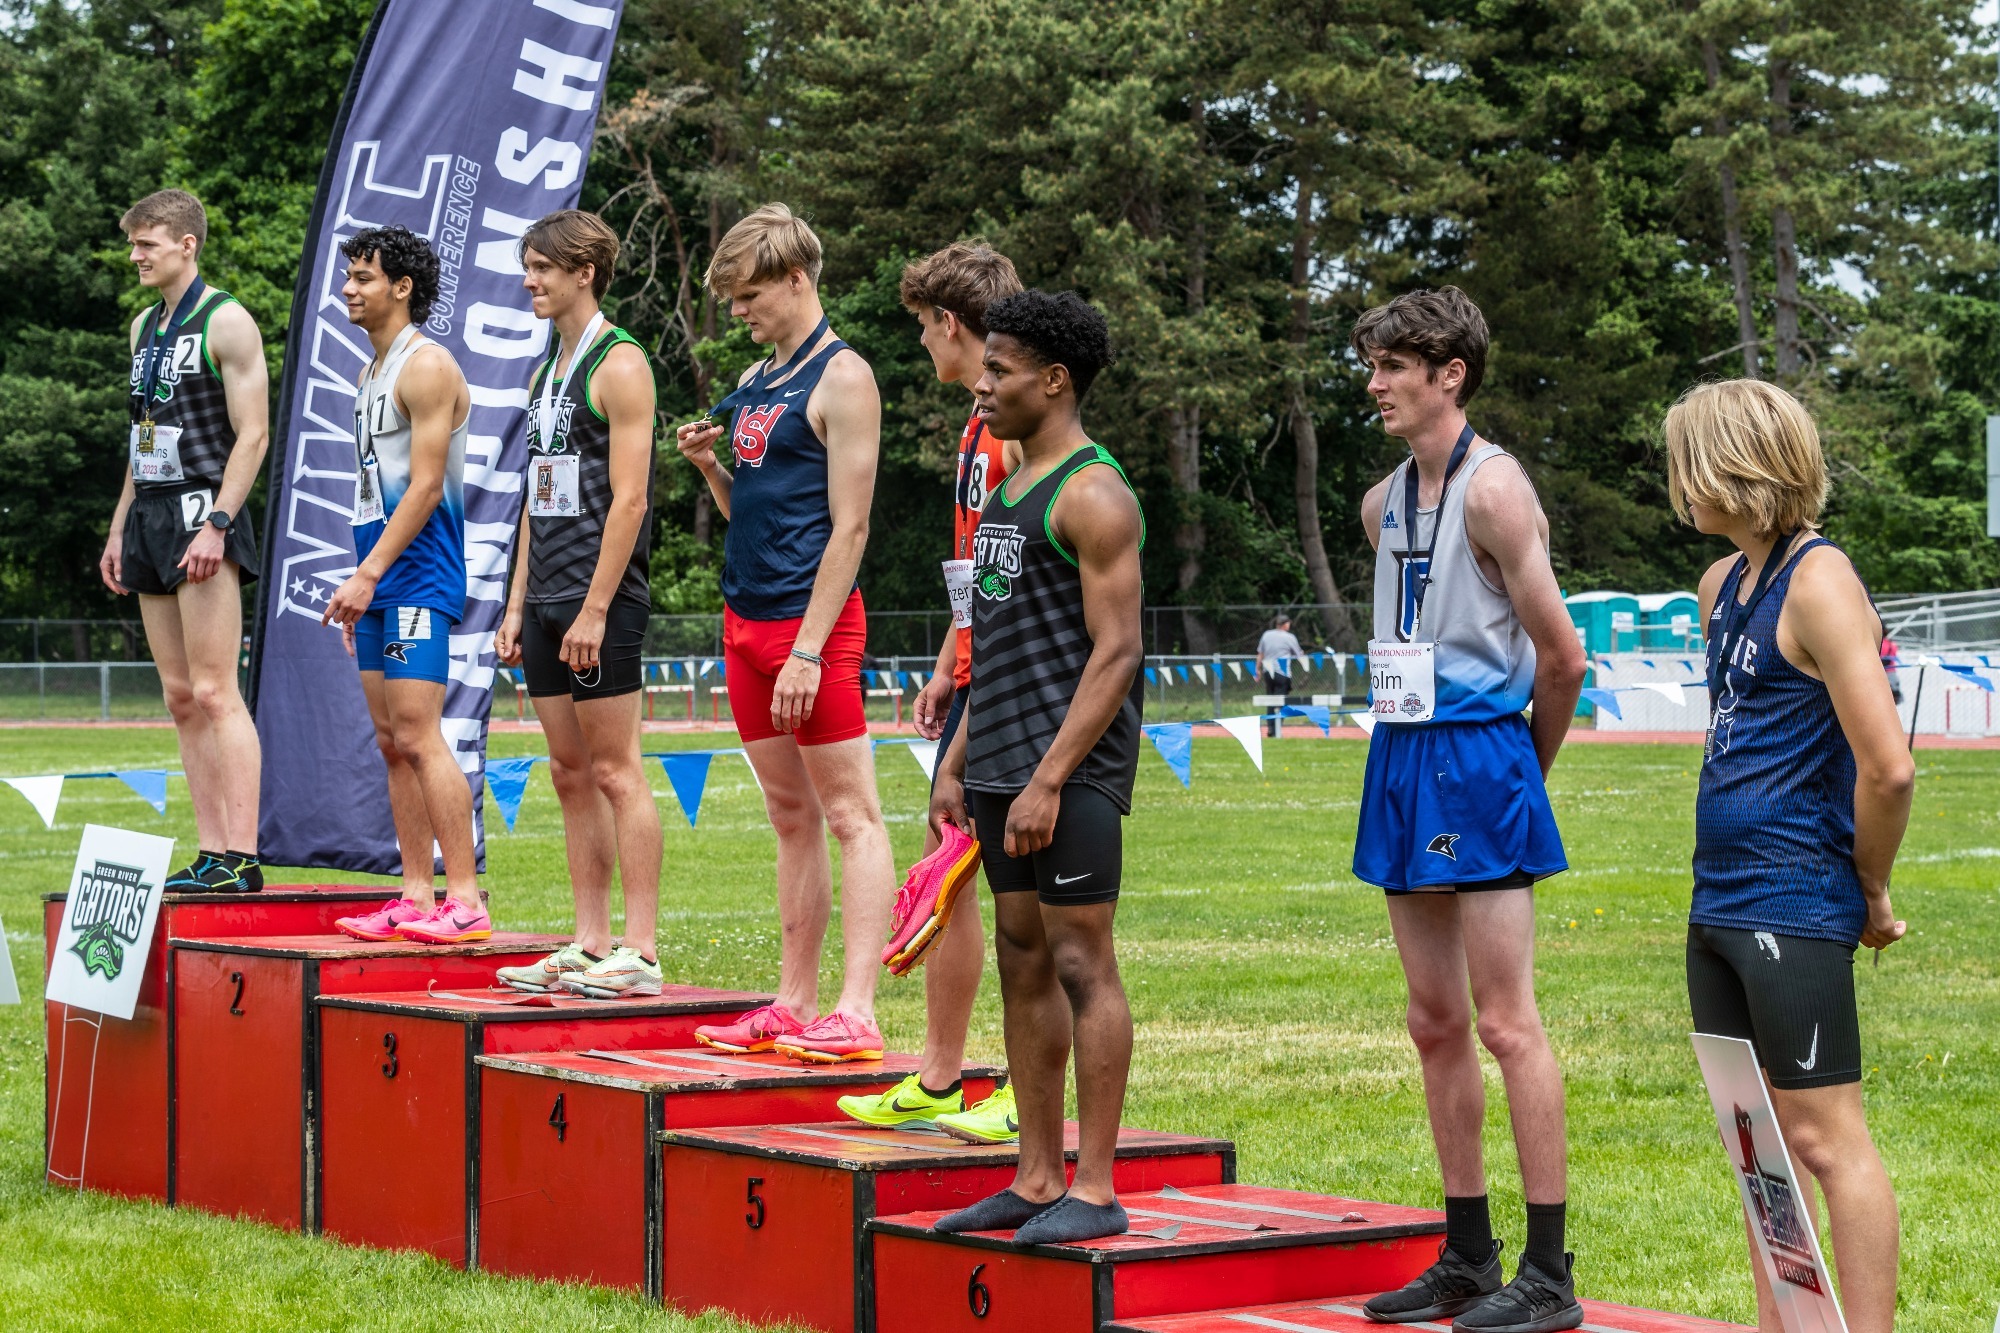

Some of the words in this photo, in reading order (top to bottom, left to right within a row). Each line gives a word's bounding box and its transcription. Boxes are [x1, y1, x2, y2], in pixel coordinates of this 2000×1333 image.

[425, 155, 481, 336] CONFERENCE
[178, 337, 195, 371] 2
[377, 393, 387, 432] 7
[142, 464, 158, 475] 2023
[970, 462, 983, 509] 8
[189, 493, 205, 528] 2
[1369, 649, 1422, 657] HAMPIONSHIPS
[1371, 670, 1402, 690] olm
[1374, 699, 1396, 714] 023
[96, 866, 117, 879] GREEN
[117, 869, 138, 883] RIVER
[73, 876, 152, 941] GATORS
[230, 971, 245, 1016] 2
[382, 1032, 397, 1079] 3
[548, 1092, 567, 1142] 4
[745, 1177, 765, 1230] 5
[968, 1263, 990, 1319] 6
[1778, 1260, 1816, 1288] PENGUINS
